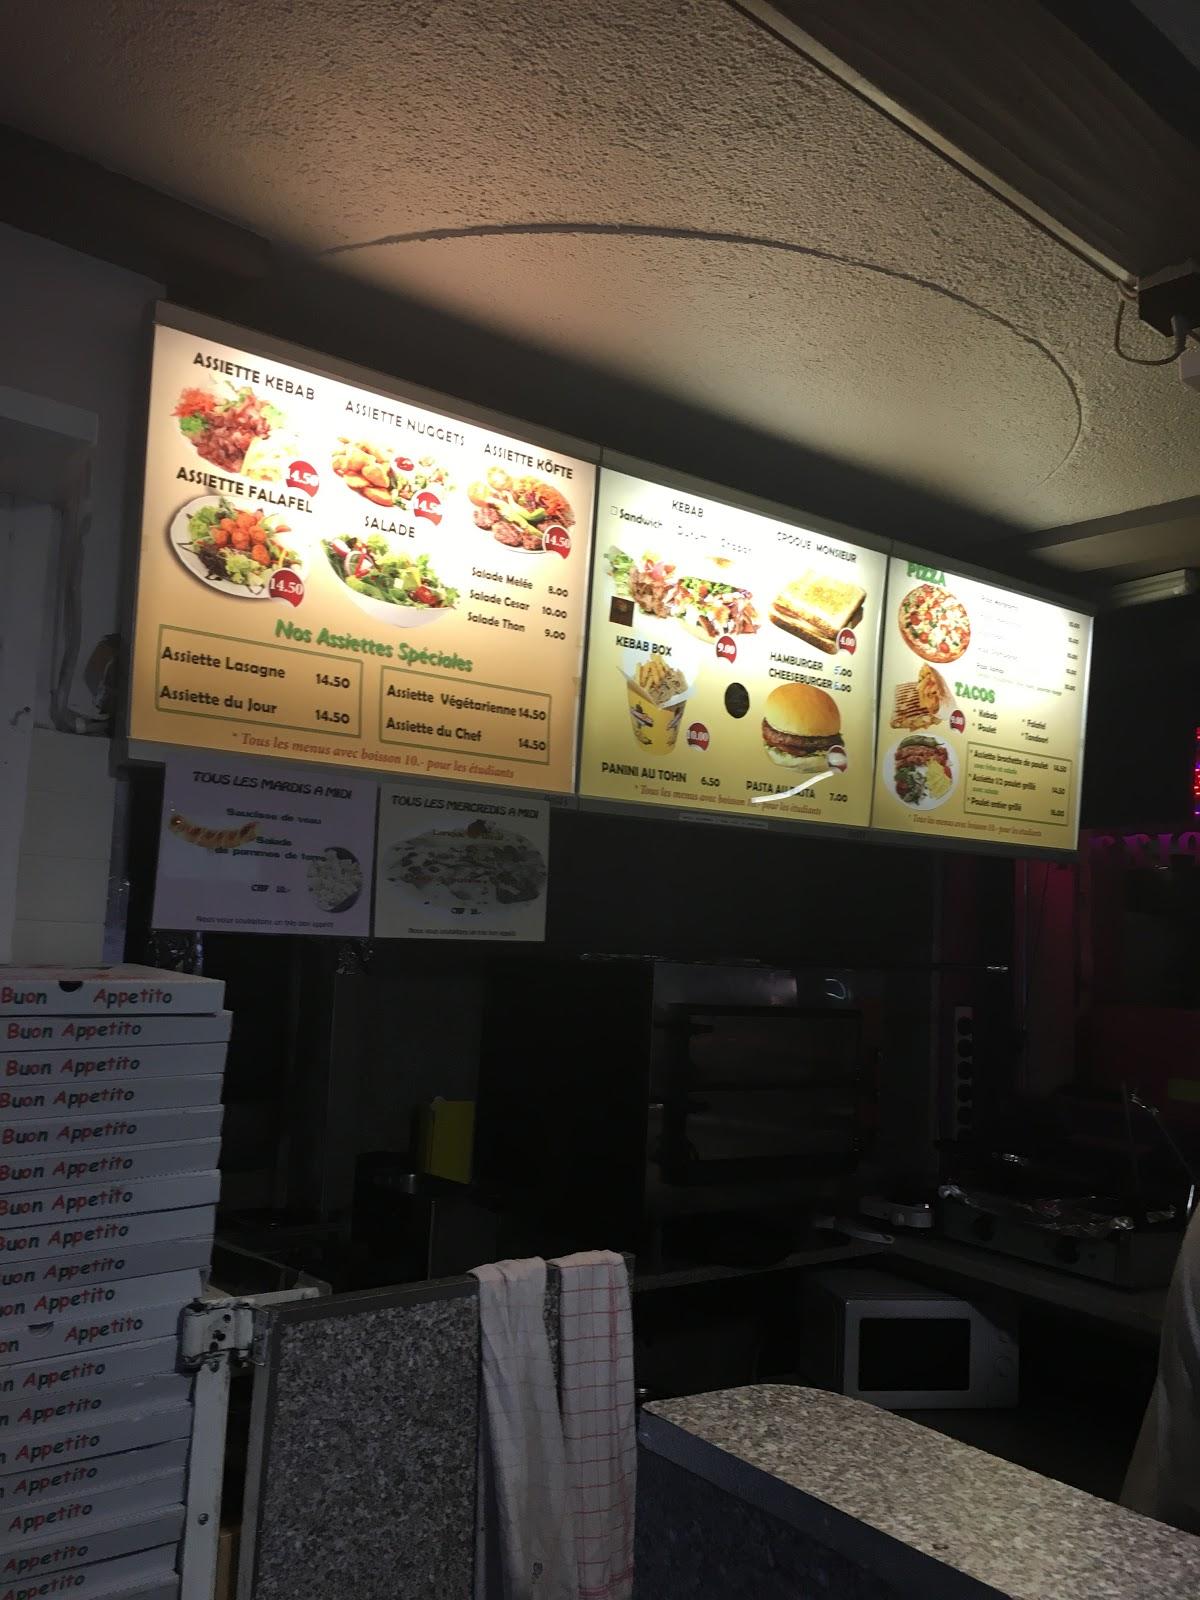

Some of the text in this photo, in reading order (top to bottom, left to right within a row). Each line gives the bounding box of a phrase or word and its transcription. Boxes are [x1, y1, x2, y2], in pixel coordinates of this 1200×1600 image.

[193, 352, 315, 400] ASSIETTE KEBAB
[345, 400, 465, 446] ASSIETTE NUGGETS
[484, 443, 533, 468] ASSIETTE
[176, 466, 313, 514] ASSIETTE FALAFEL
[672, 500, 704, 518] KEBAB
[365, 515, 415, 538] SALADE
[269, 578, 303, 594] 14.50
[472, 566, 503, 581] Salade
[548, 585, 569, 597] 8.00
[469, 589, 568, 619] Salade Cesar 10.00
[467, 612, 566, 641] Salade Thon 9.00
[275, 618, 473, 672] Nos Assiettes Spéciales
[616, 635, 673, 657] KEBAB BOX
[161, 646, 351, 689] Assiette Lasagne 14.50
[770, 651, 823, 672] HAMBURGER
[769, 667, 833, 690] CHEESEBURGER
[160, 685, 350, 724] Assiette du Jour 14.50
[387, 685, 546, 720] Assiette Végétarienne 14.50
[954, 681, 996, 704] TACOS
[386, 717, 546, 751] Assiette du Chef 14.50
[241, 732, 269, 748] Tous
[274, 736, 289, 750] les
[292, 743, 330, 755] menus
[333, 749, 358, 759] avec
[361, 749, 402, 764] boisson
[426, 760, 451, 772] pour
[454, 761, 466, 773] les
[193, 770, 353, 800] TOUS LES MARDIS A MIDI
[602, 762, 720, 788] PANINI AU TOHN 6.50
[392, 795, 422, 807] TOUS
[424, 799, 444, 809] LES
[746, 780, 773, 794] PASTA
[829, 792, 849, 803] 7.00
[1, 987, 172, 1008] Buon Appetito
[7, 1021, 142, 1041] Buon Appetito
[6, 1057, 140, 1077] Buon Appetito
[0, 1088, 134, 1109] Buon Appetito
[2, 1121, 137, 1144] Buon Appetito
[0, 1157, 133, 1180] Buon Appetito
[0, 1190, 133, 1216] Buon Appetito
[49, 1224, 129, 1248] Appetito
[44, 1259, 124, 1281] Appetito
[34, 1288, 115, 1314] Appetito
[64, 1317, 143, 1345] Appetito
[23, 1363, 105, 1390] Appetito
[17, 1399, 102, 1424] Appetito
[15, 1435, 100, 1463] Appetito
[13, 1467, 98, 1496] Appetito
[9, 1504, 93, 1534] Appetito
[4, 1546, 88, 1574] Appetito
